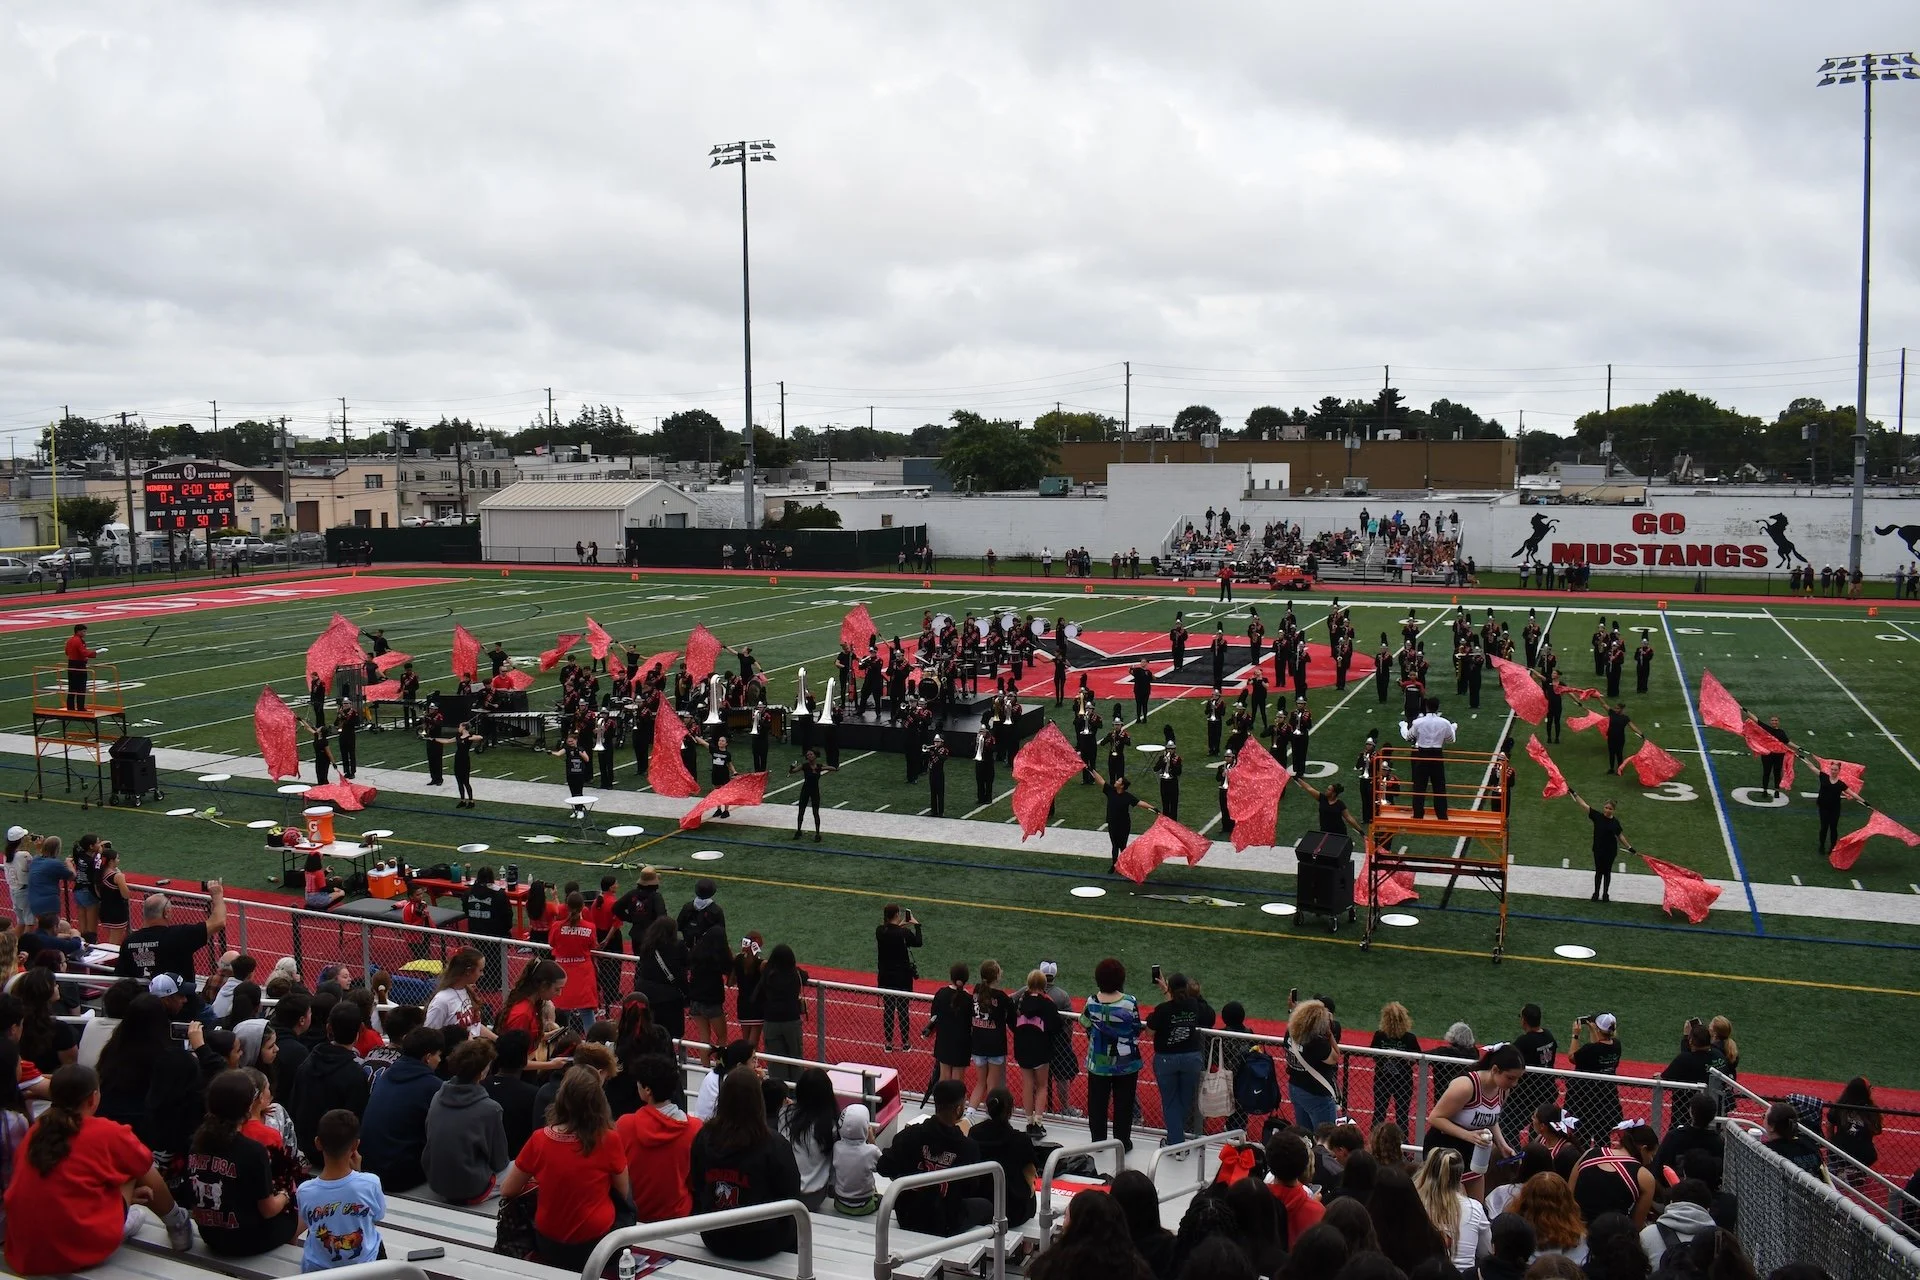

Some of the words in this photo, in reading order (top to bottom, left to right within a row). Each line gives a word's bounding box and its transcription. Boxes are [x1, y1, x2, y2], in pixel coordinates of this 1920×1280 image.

[197, 471, 231, 479] MUSTANGS
[146, 484, 174, 492] MINEOLA
[181, 483, 203, 495] 12:00
[160, 492, 167, 504] 0
[214, 490, 226, 502] 26
[176, 516, 185, 527] 10
[197, 514, 209, 526] 50
[222, 514, 228, 525] 3
[1632, 512, 1686, 535] GO
[1551, 543, 1768, 567] MUSTANGS
